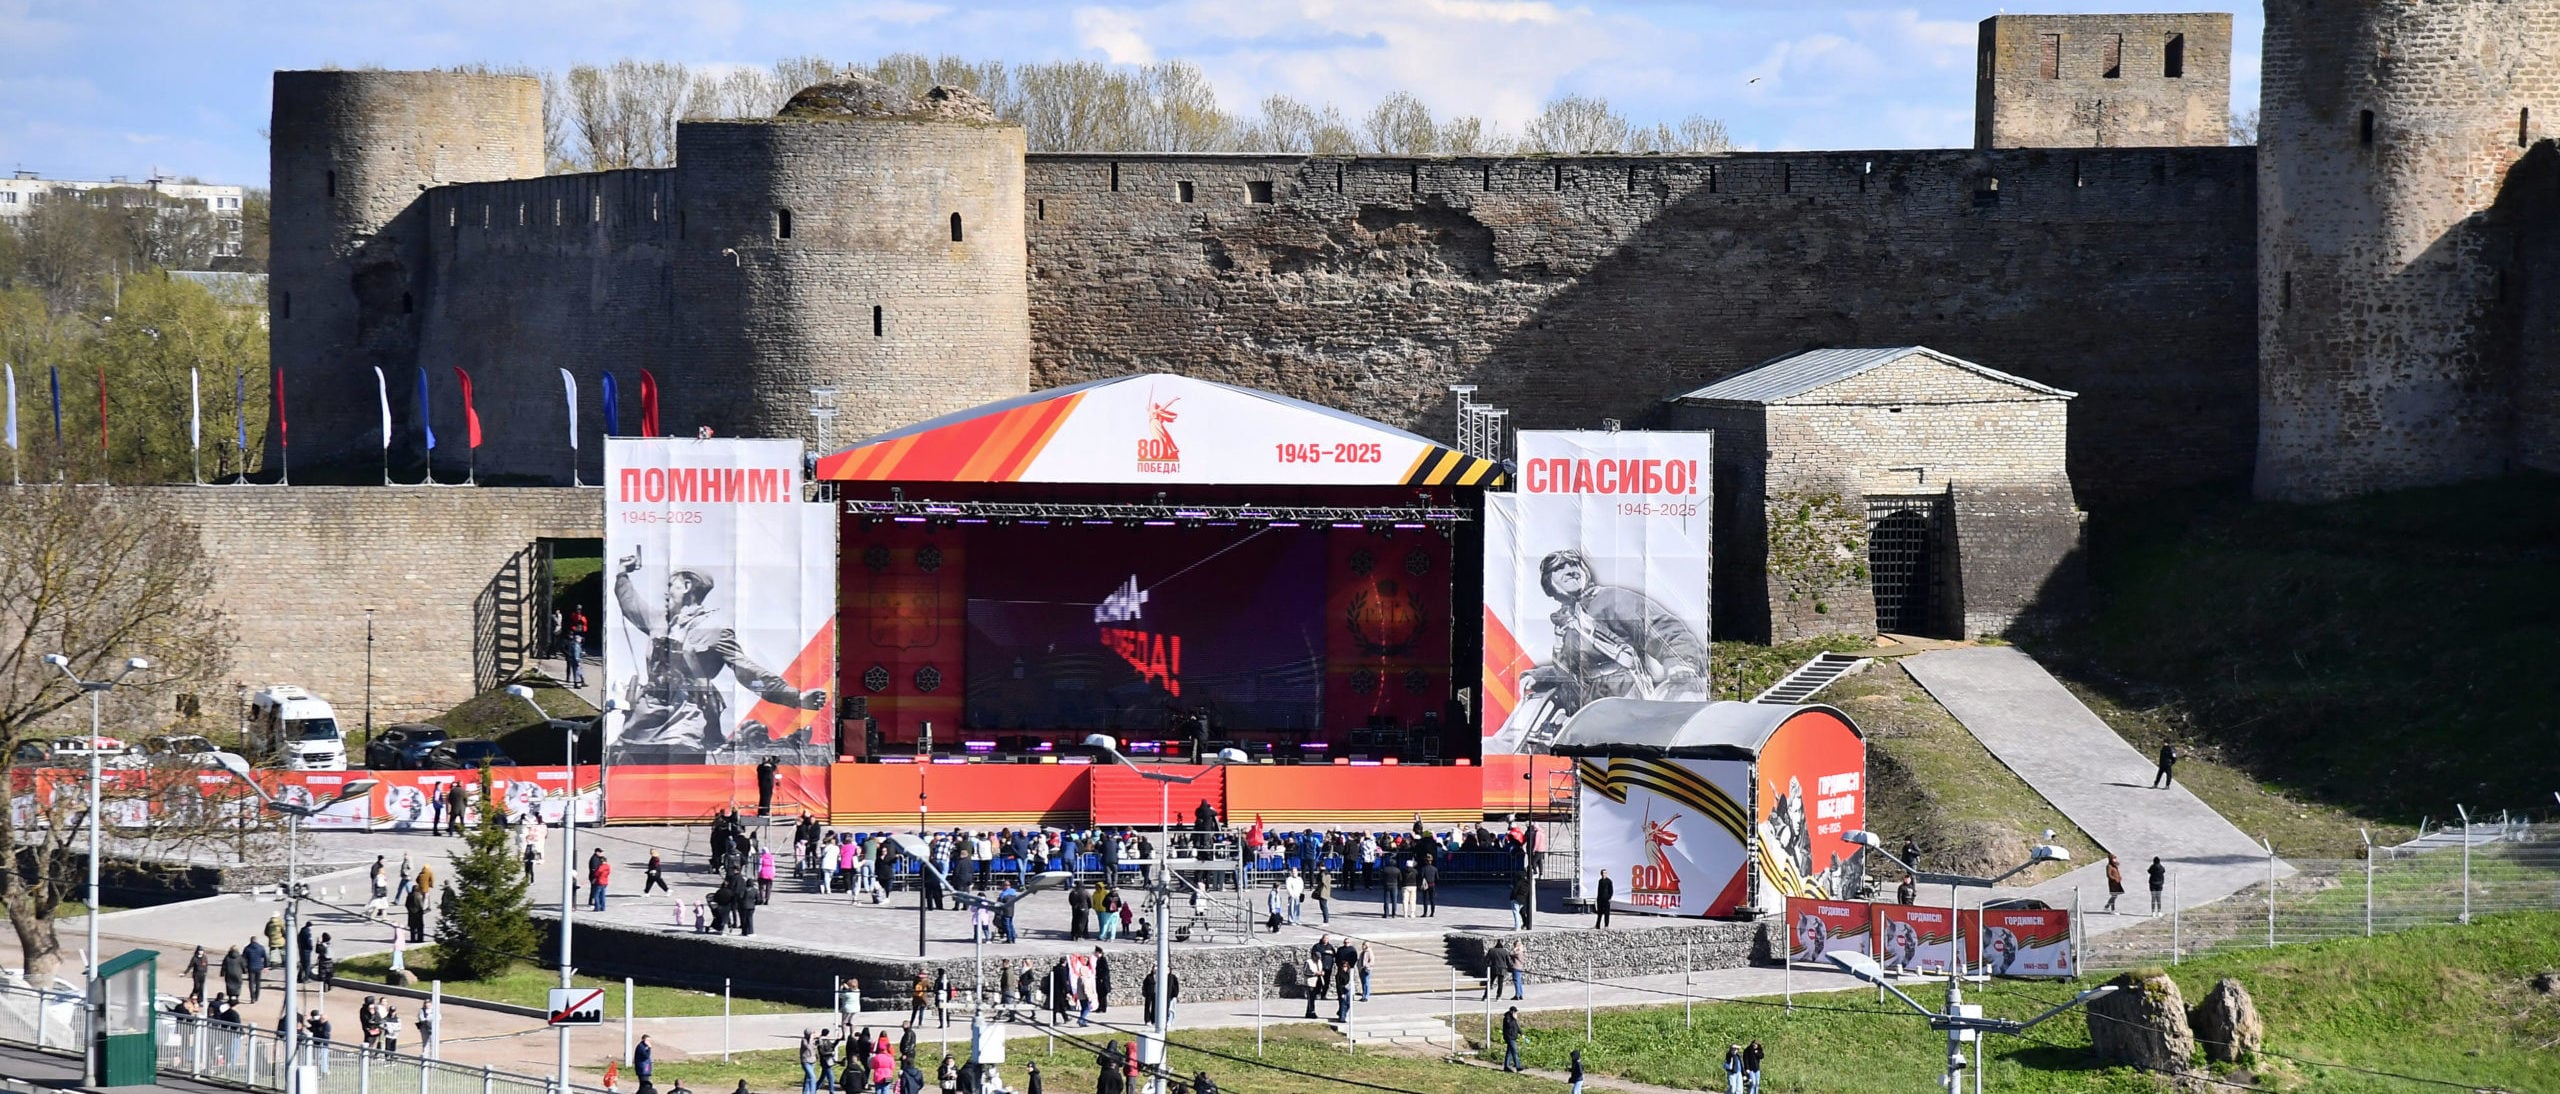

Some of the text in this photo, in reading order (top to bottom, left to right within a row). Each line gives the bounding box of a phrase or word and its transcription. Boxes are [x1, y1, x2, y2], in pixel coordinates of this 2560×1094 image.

[1137, 439, 1160, 460] 80
[1275, 443, 1382, 463] 1945–2025
[1137, 462, 1180, 474] ПОБЕДА!
[1526, 458, 1697, 495] СПАСИБО!
[620, 468, 791, 503] ПОМНИМ!
[1631, 864, 1659, 890] 80
[1631, 894, 1681, 909] ПОБЕДА!
